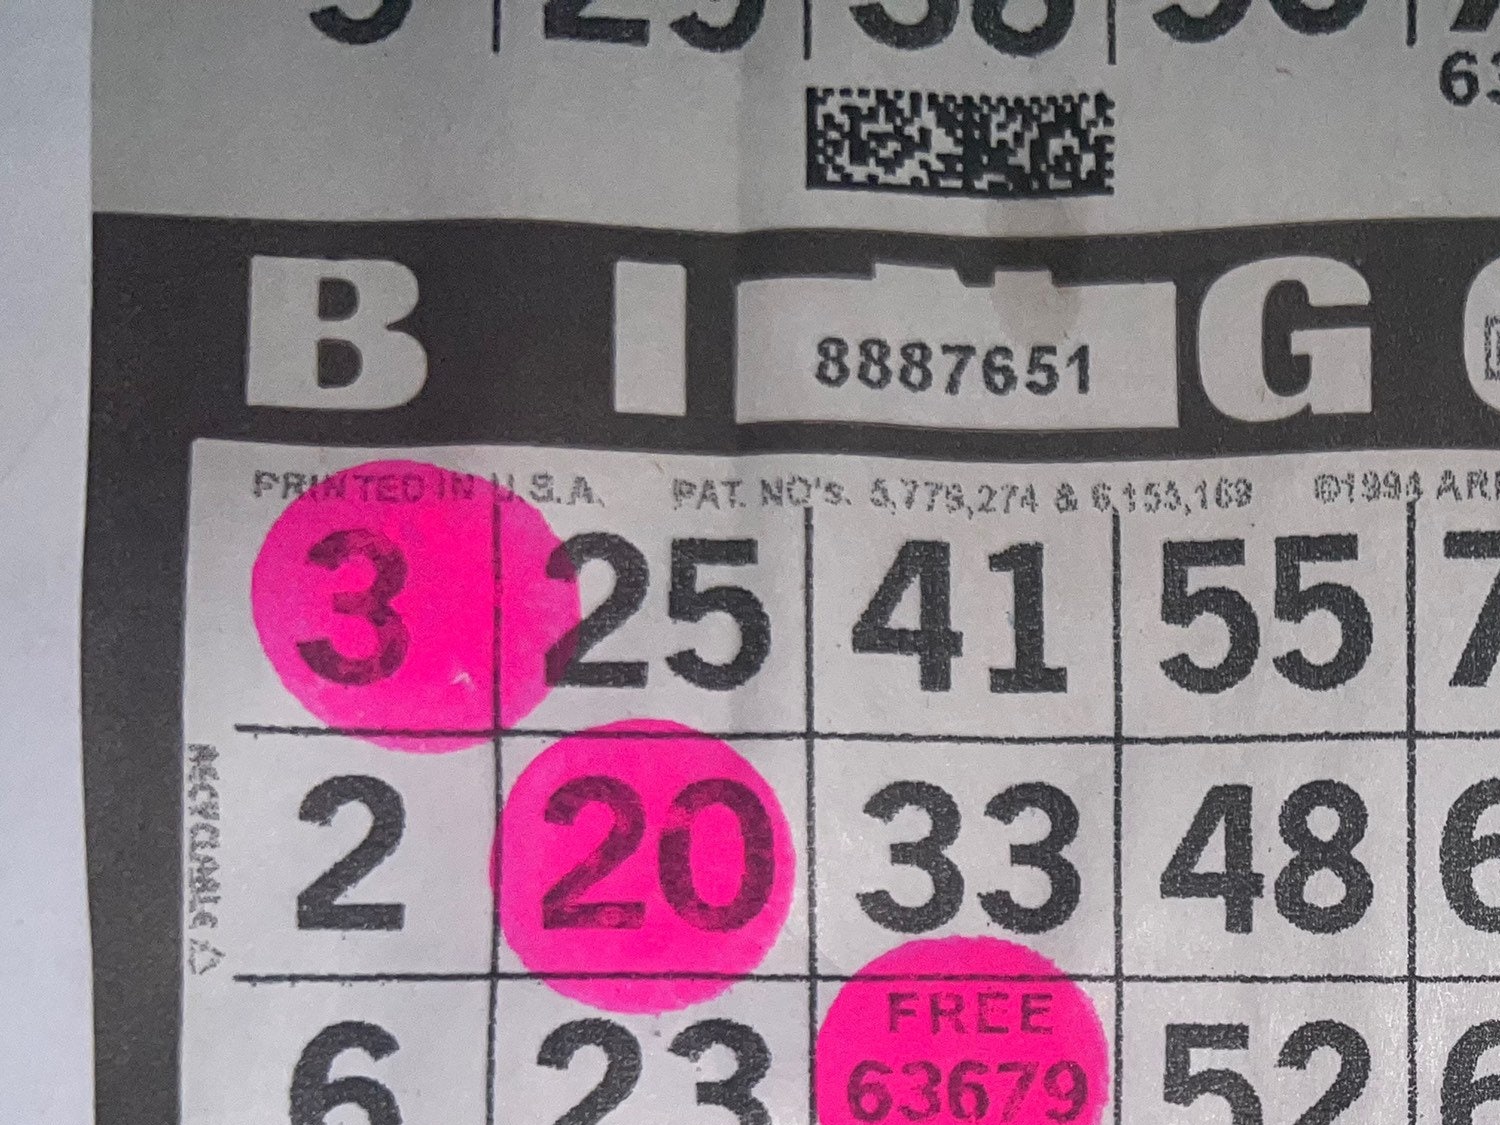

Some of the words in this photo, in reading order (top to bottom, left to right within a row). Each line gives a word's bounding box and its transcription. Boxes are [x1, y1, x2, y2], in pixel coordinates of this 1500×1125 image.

[246, 255, 428, 410] B
[816, 337, 1089, 395] 8887651
[1199, 255, 1372, 422] G
[252, 467, 423, 503] PRINTED
[437, 470, 477, 500] IN
[673, 479, 746, 508] PAT.
[1056, 483, 1077, 513] &
[296, 530, 407, 685] 3
[547, 532, 771, 690] 25
[852, 540, 1067, 693] 41
[1160, 533, 1373, 693] 55
[297, 775, 405, 930] 2
[542, 776, 774, 931] 20
[857, 781, 1081, 934] 33
[1160, 779, 1373, 934] 48
[888, 992, 1052, 1034] FREE
[848, 1060, 1088, 1123] 63679
